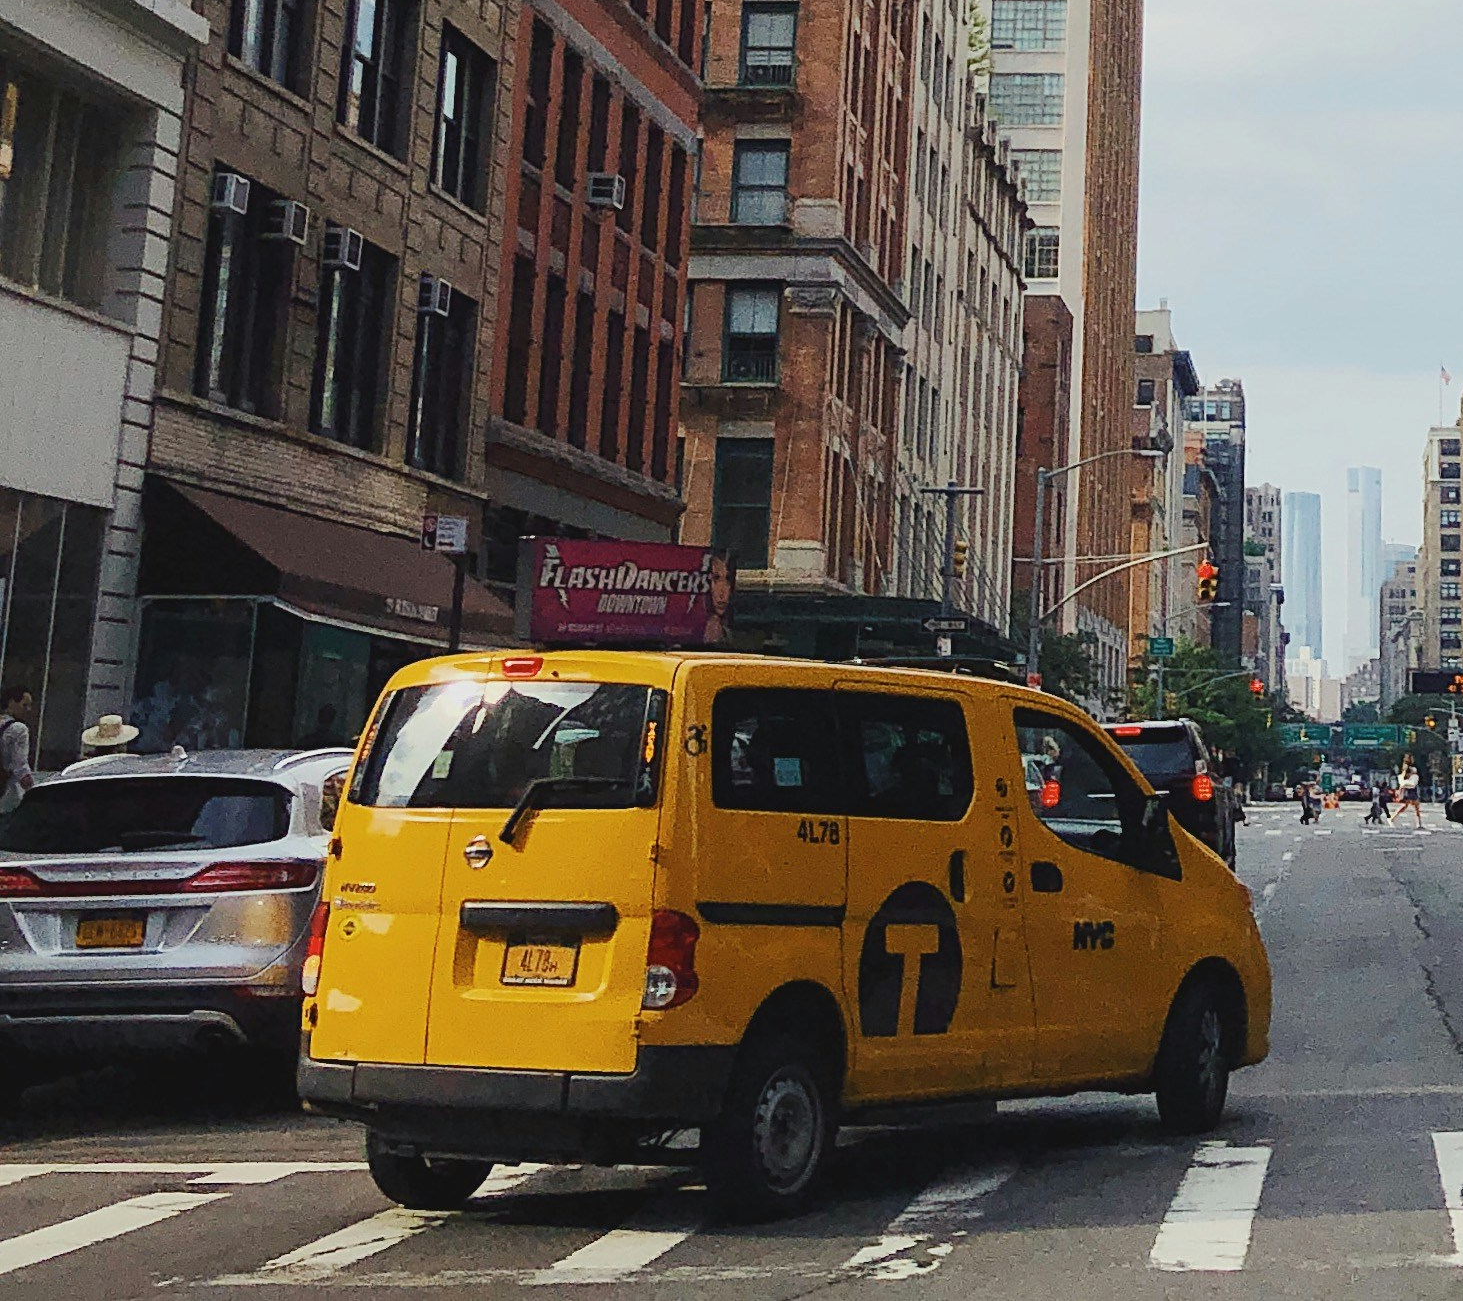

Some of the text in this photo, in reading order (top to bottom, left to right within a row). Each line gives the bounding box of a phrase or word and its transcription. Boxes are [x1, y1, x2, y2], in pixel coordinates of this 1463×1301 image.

[597, 593, 668, 615] DOWNTOWN
[797, 820, 841, 845] 4L78
[1072, 920, 1115, 951] NYC
